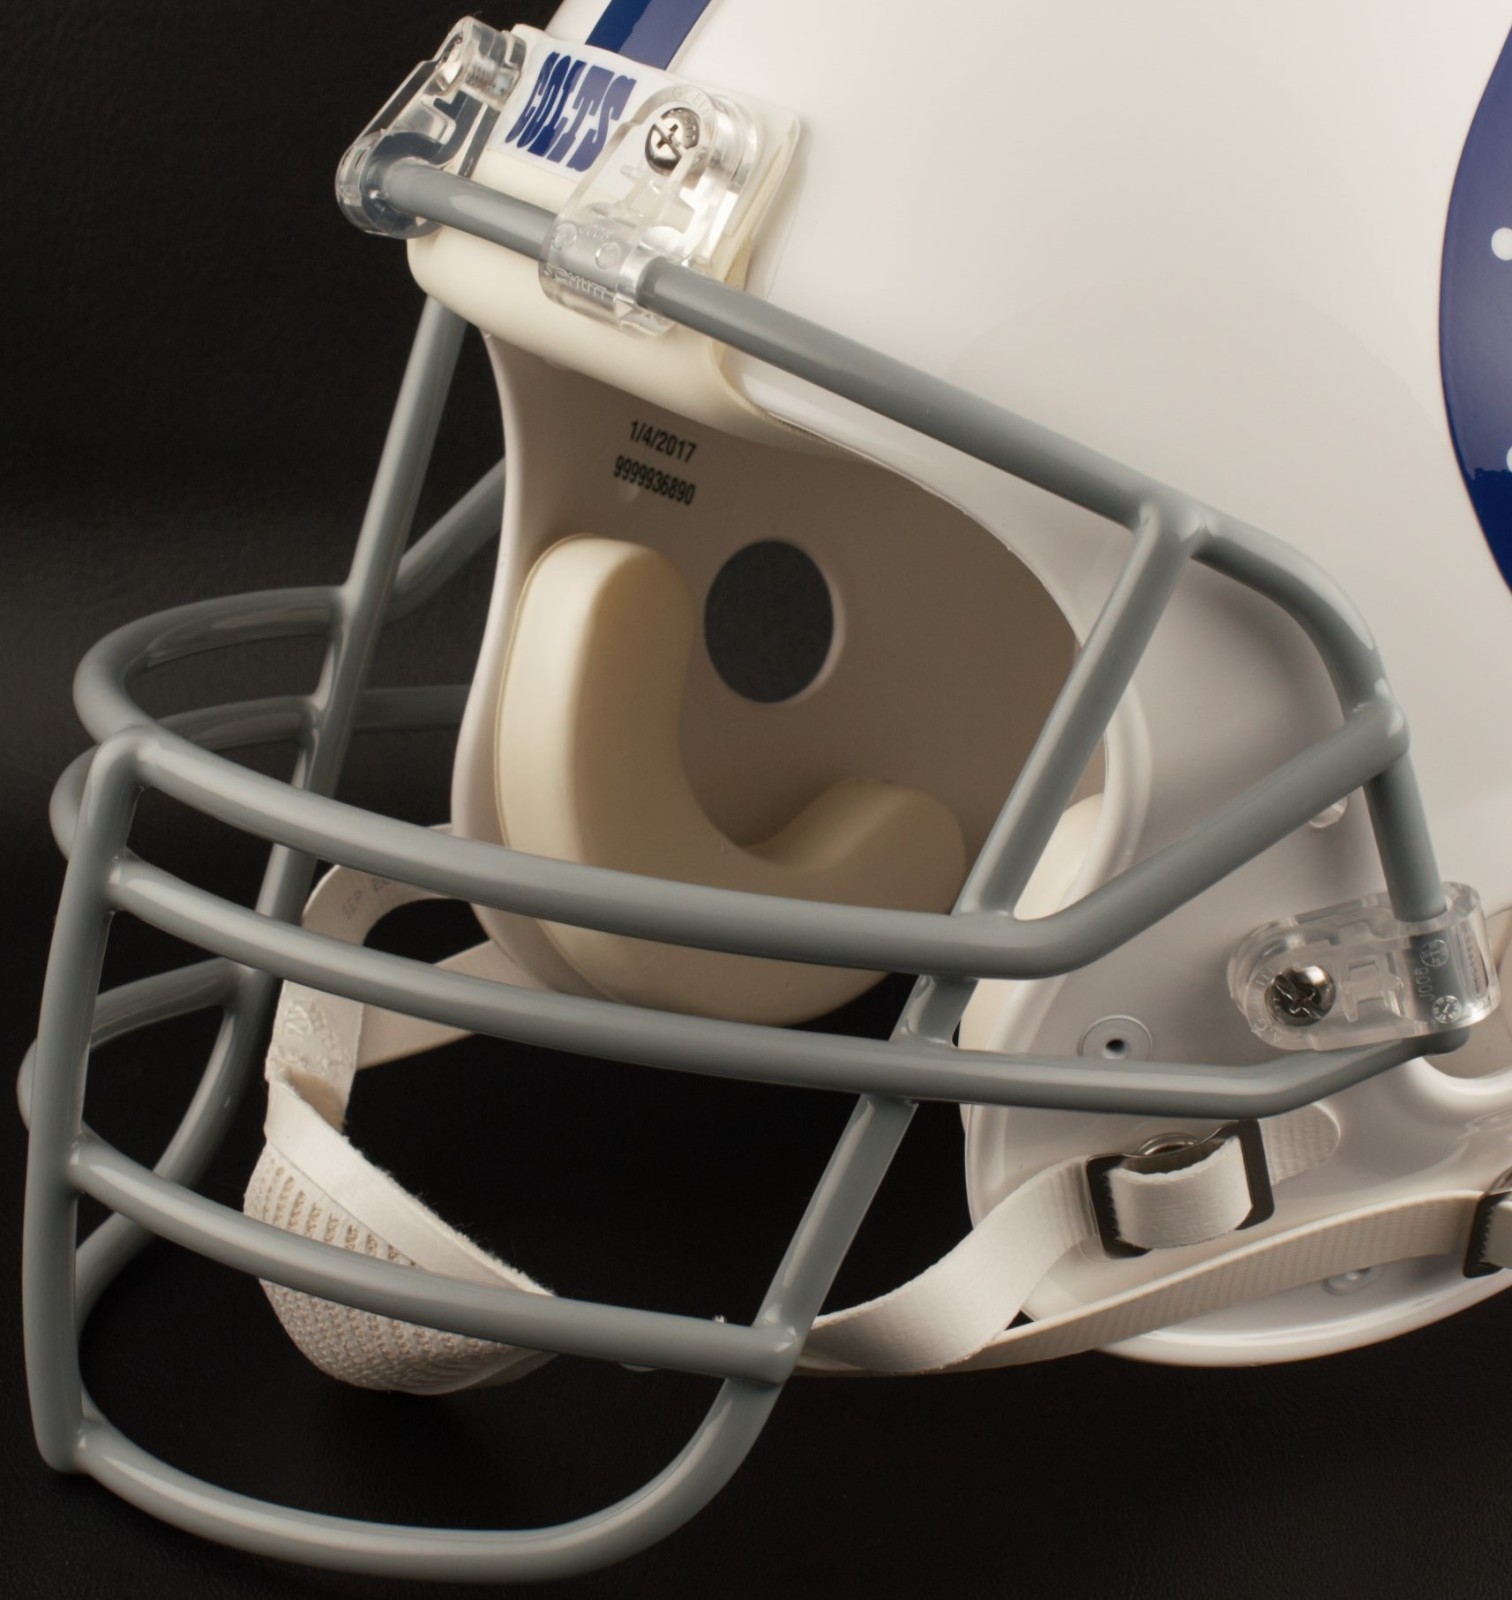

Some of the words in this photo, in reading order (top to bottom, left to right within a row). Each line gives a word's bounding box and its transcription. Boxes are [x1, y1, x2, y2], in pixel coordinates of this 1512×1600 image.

[505, 51, 637, 172] COLTS
[630, 420, 698, 463] 1/4/2017
[613, 454, 697, 506] 9999936890
